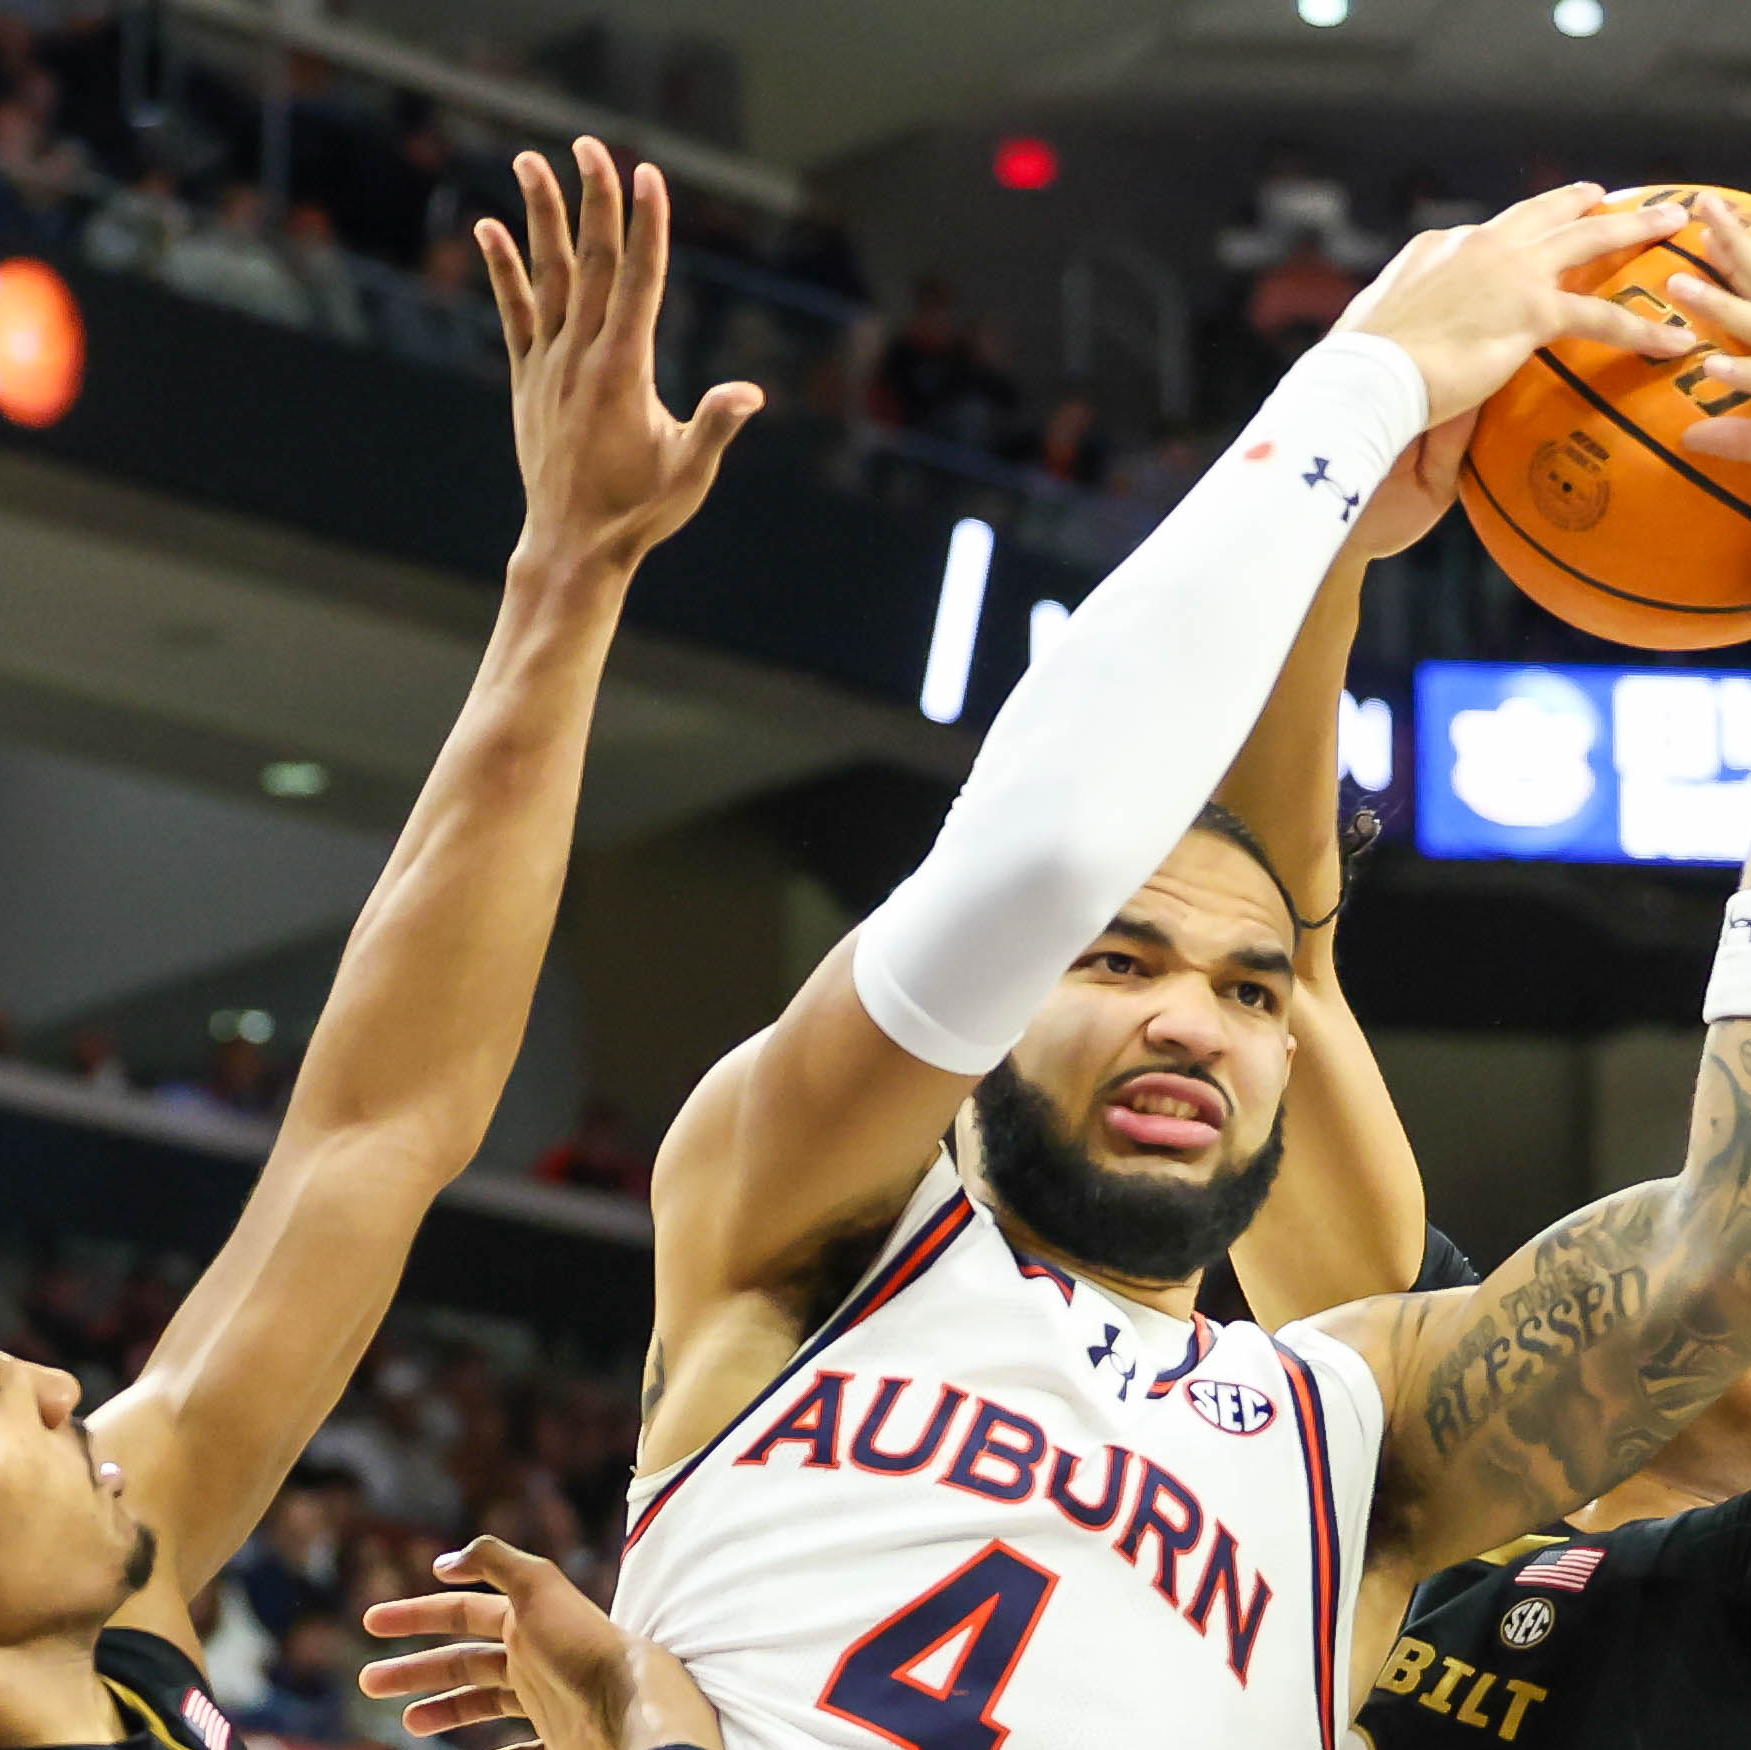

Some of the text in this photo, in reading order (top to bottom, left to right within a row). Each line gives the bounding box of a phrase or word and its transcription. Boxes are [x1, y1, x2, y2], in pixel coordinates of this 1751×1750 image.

[1188, 1380, 1273, 1434] SEC
[733, 1368, 1274, 1690] AUBURN
[1503, 1601, 1551, 1645] SEC
